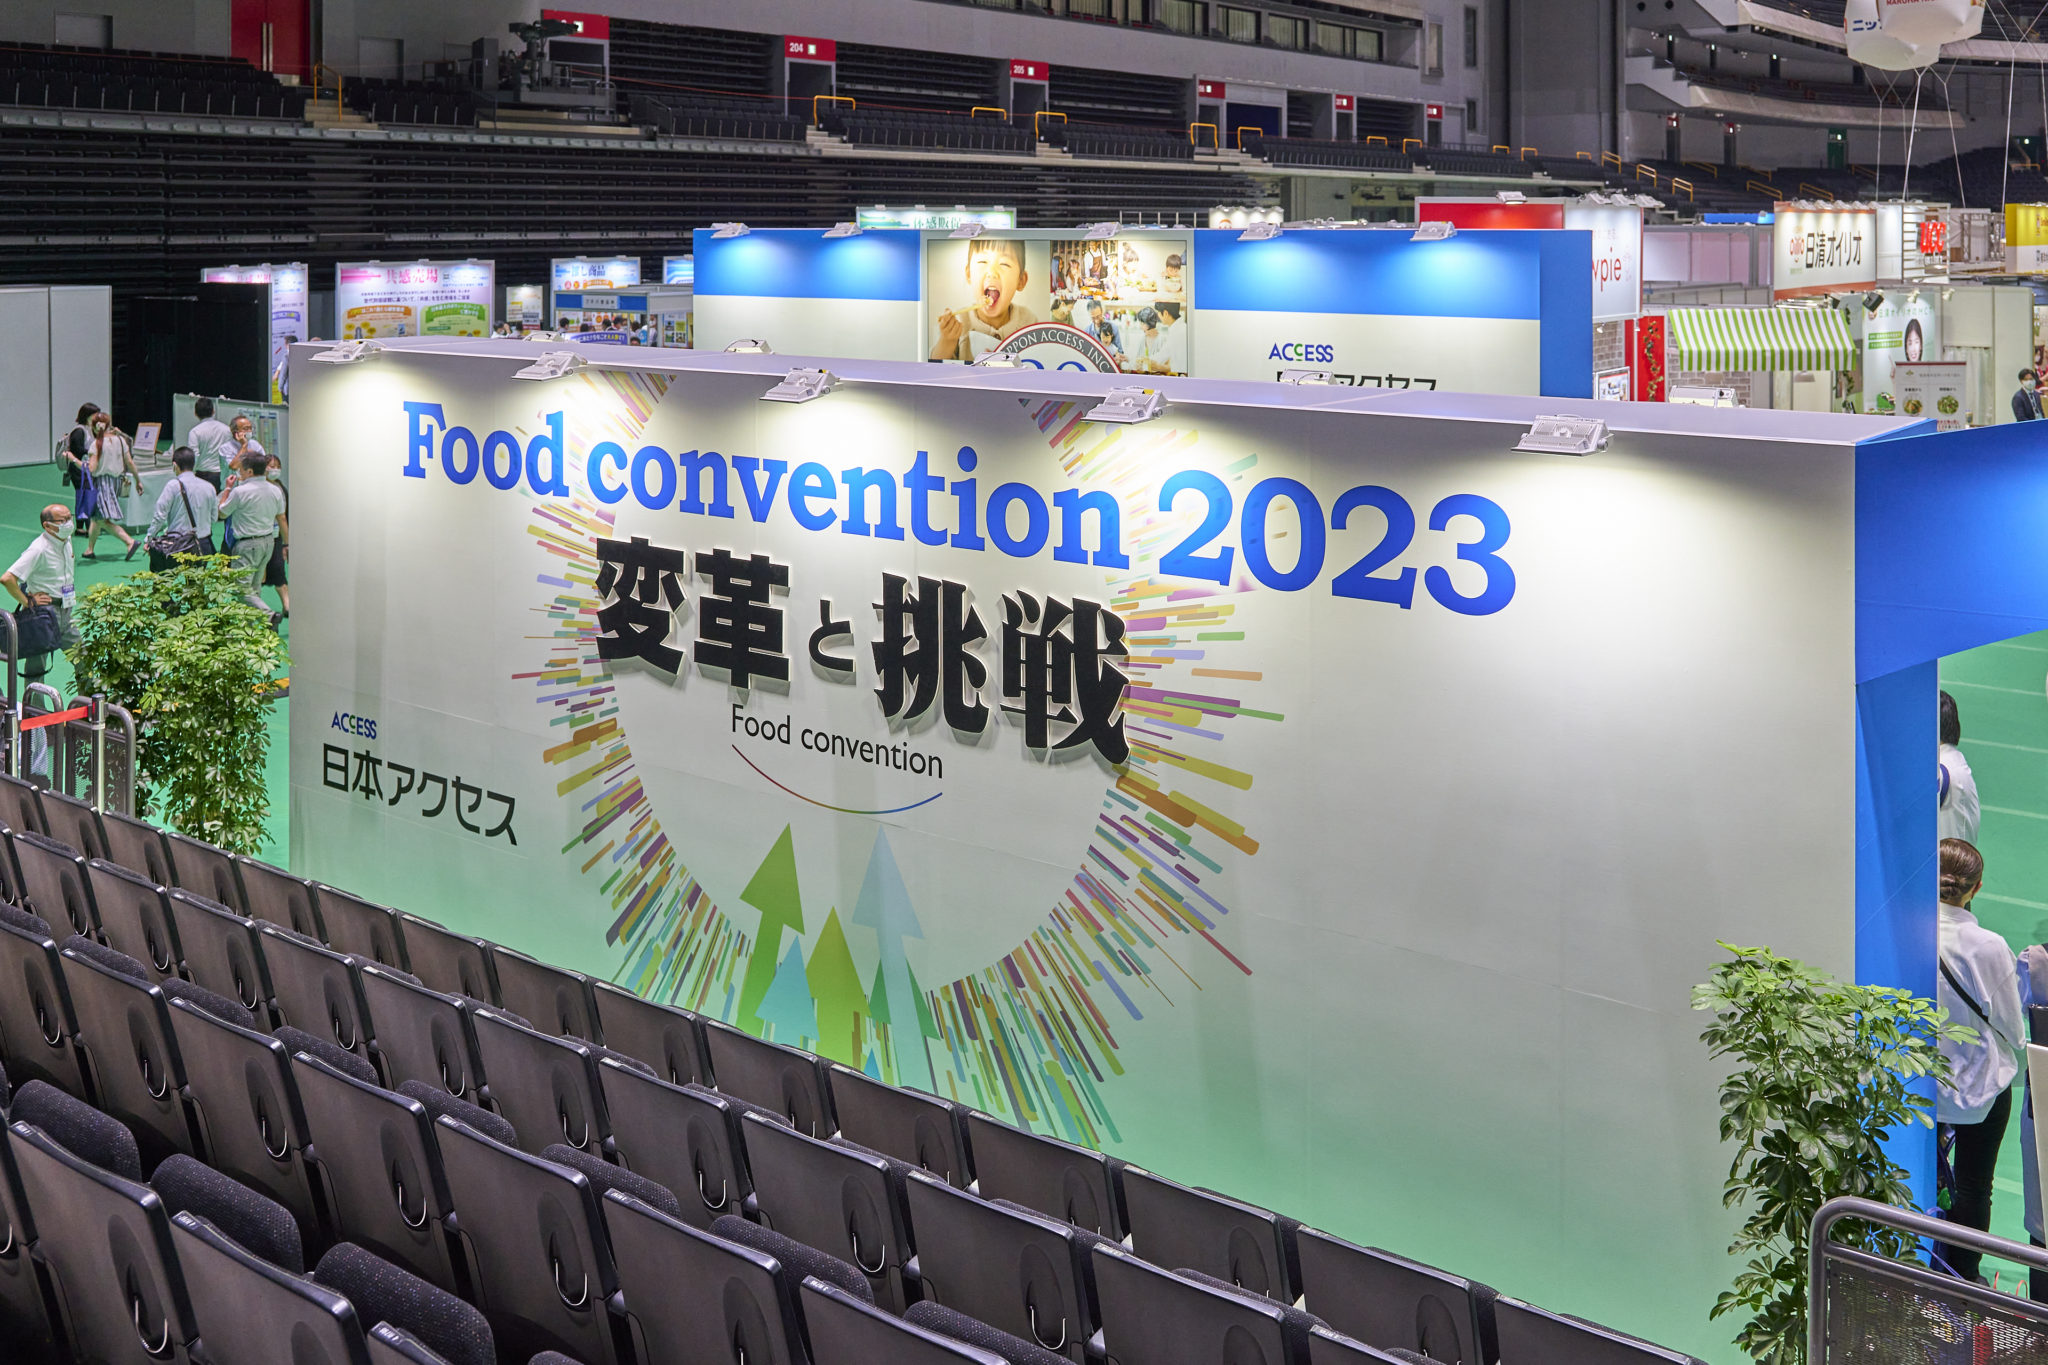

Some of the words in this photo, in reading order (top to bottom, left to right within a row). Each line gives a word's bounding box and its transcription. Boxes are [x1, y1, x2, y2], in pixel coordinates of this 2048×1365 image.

[1852, 19, 1883, 32] ニッ
[789, 42, 804, 53] 204
[1805, 230, 1862, 269] 日清オイリオ
[1005, 332, 1038, 354] PPON
[1040, 329, 1085, 352] ACCESS,
[1268, 341, 1334, 363] ACCESS
[403, 400, 570, 498] Food
[587, 441, 1130, 570] convention
[1158, 469, 1516, 616] 2023
[595, 538, 1131, 766] 変革と挑戦
[330, 711, 378, 740] ACCESS
[732, 703, 791, 745] Food
[801, 728, 943, 780] convention
[322, 742, 518, 846] 日本アクセス
